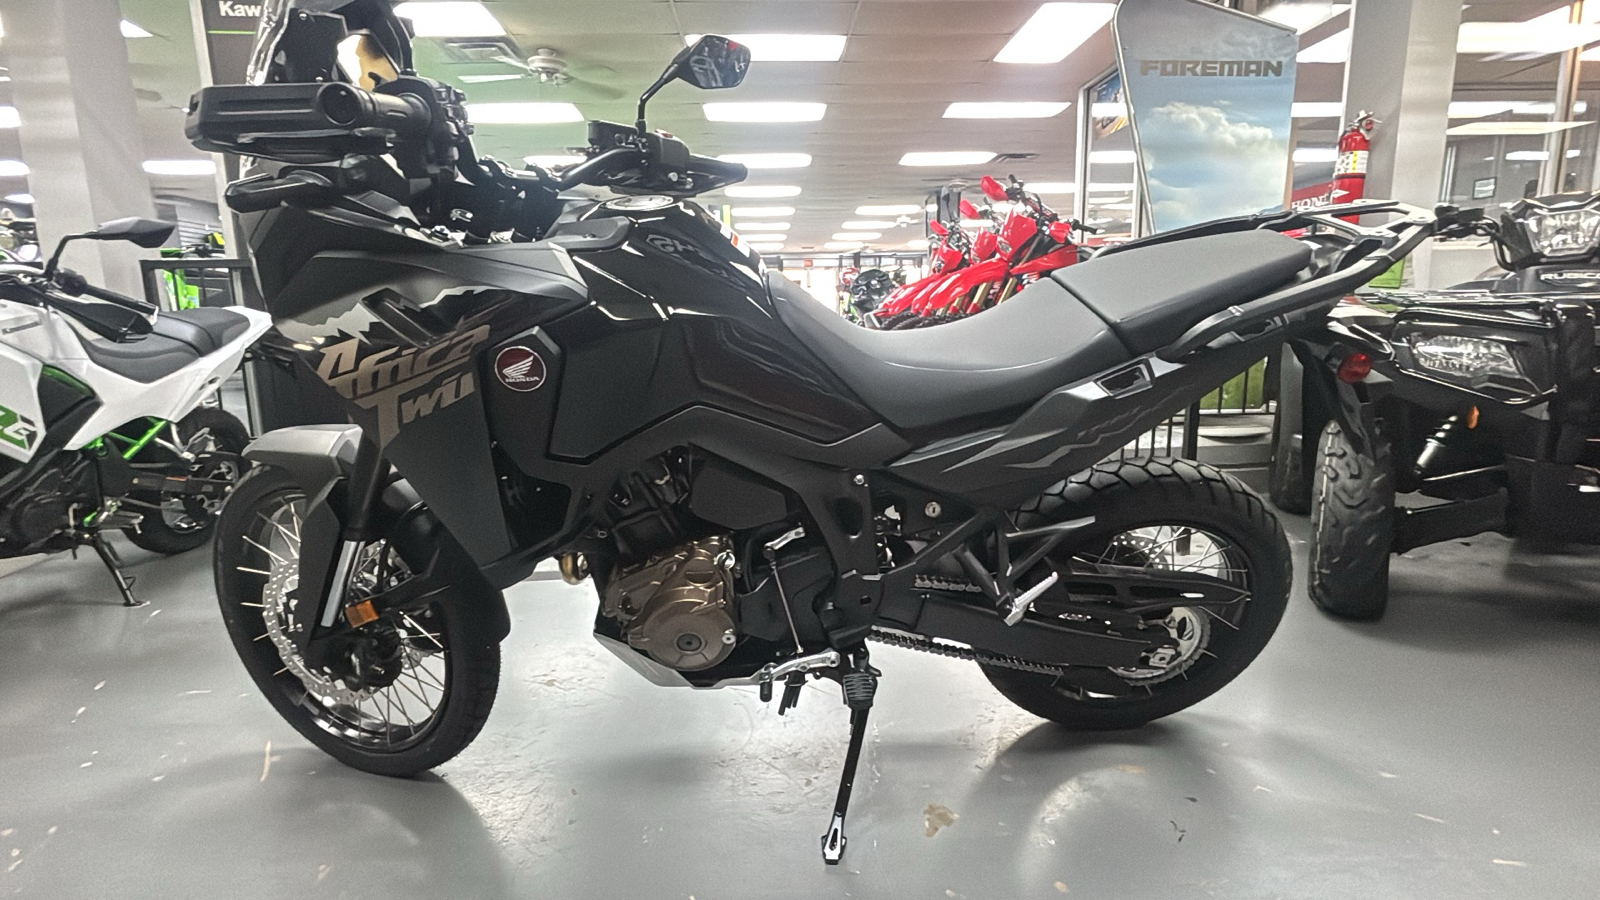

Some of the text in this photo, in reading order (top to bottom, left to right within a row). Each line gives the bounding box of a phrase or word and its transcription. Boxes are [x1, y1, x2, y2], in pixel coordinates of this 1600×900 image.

[219, 1, 261, 17] Kaw
[1140, 60, 1282, 77] FOREMAN
[1291, 193, 1329, 210] HON
[316, 324, 491, 399] Africa
[354, 355, 476, 451] Twin
